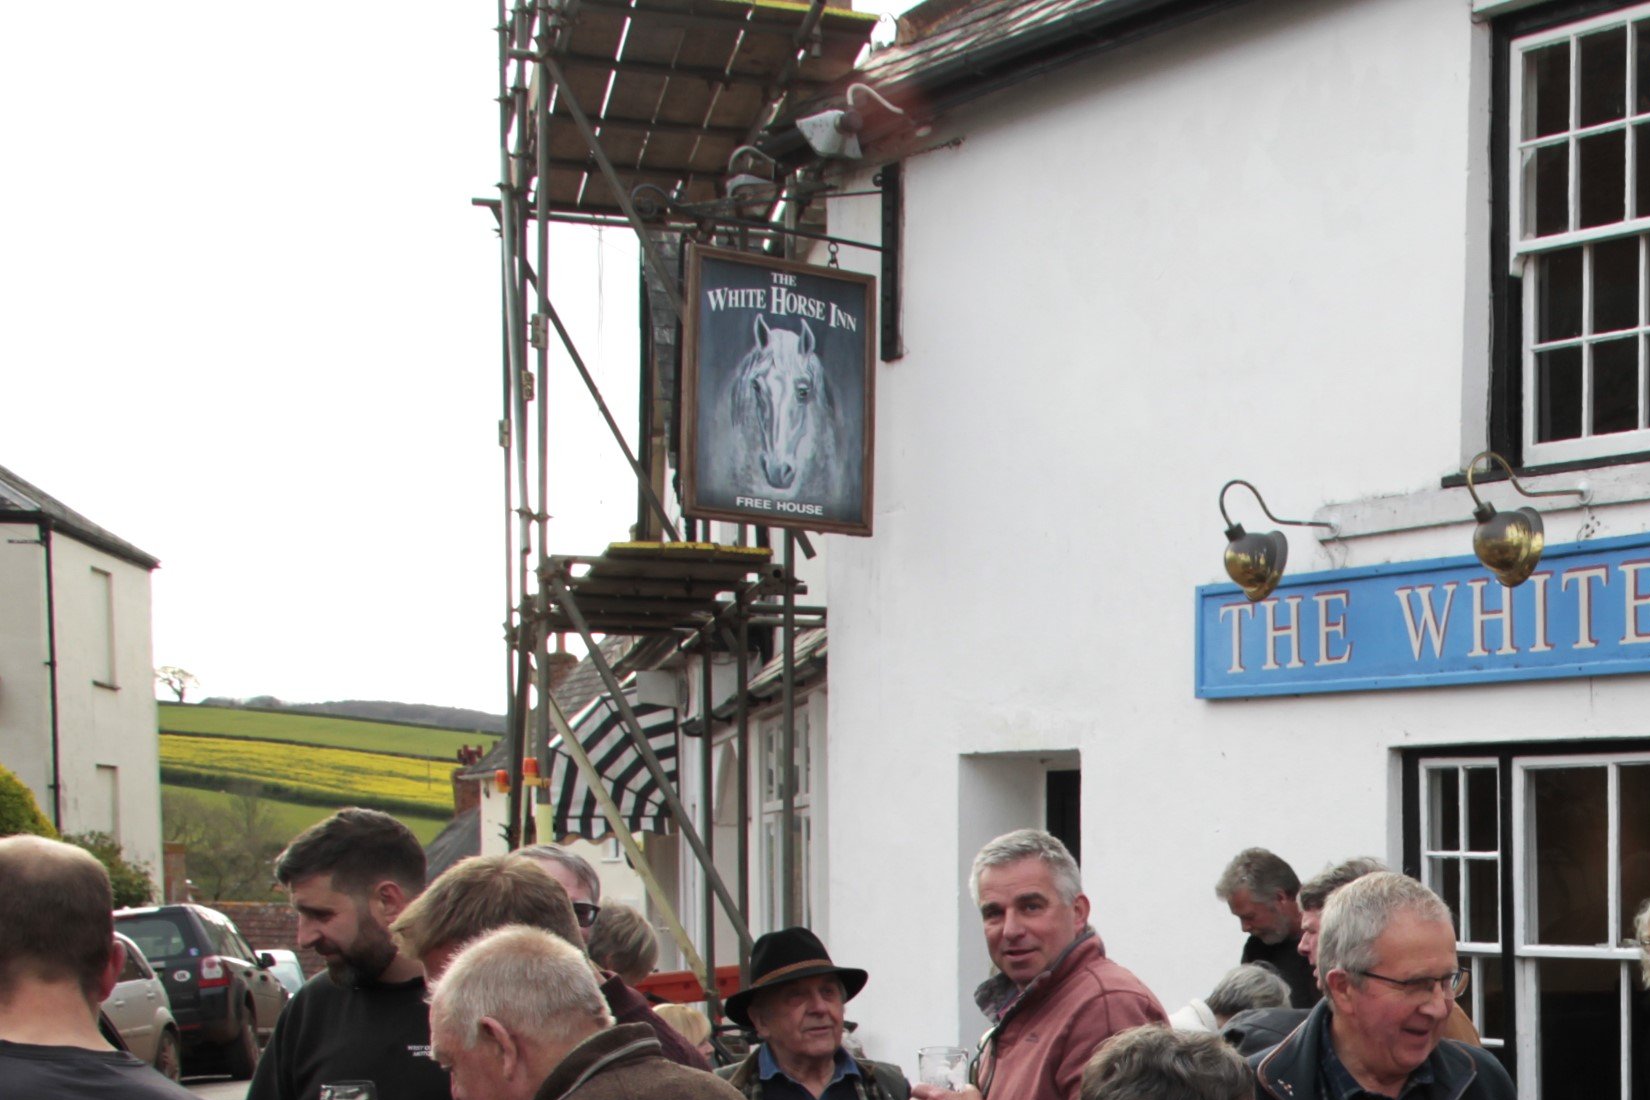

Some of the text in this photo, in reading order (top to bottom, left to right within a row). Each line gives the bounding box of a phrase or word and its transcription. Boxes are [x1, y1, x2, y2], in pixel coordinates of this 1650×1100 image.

[770, 272, 798, 287] THE
[707, 286, 857, 332] WHITE HORSE INN
[736, 496, 824, 515] FREE HOUSE
[1219, 589, 1353, 674] THE
